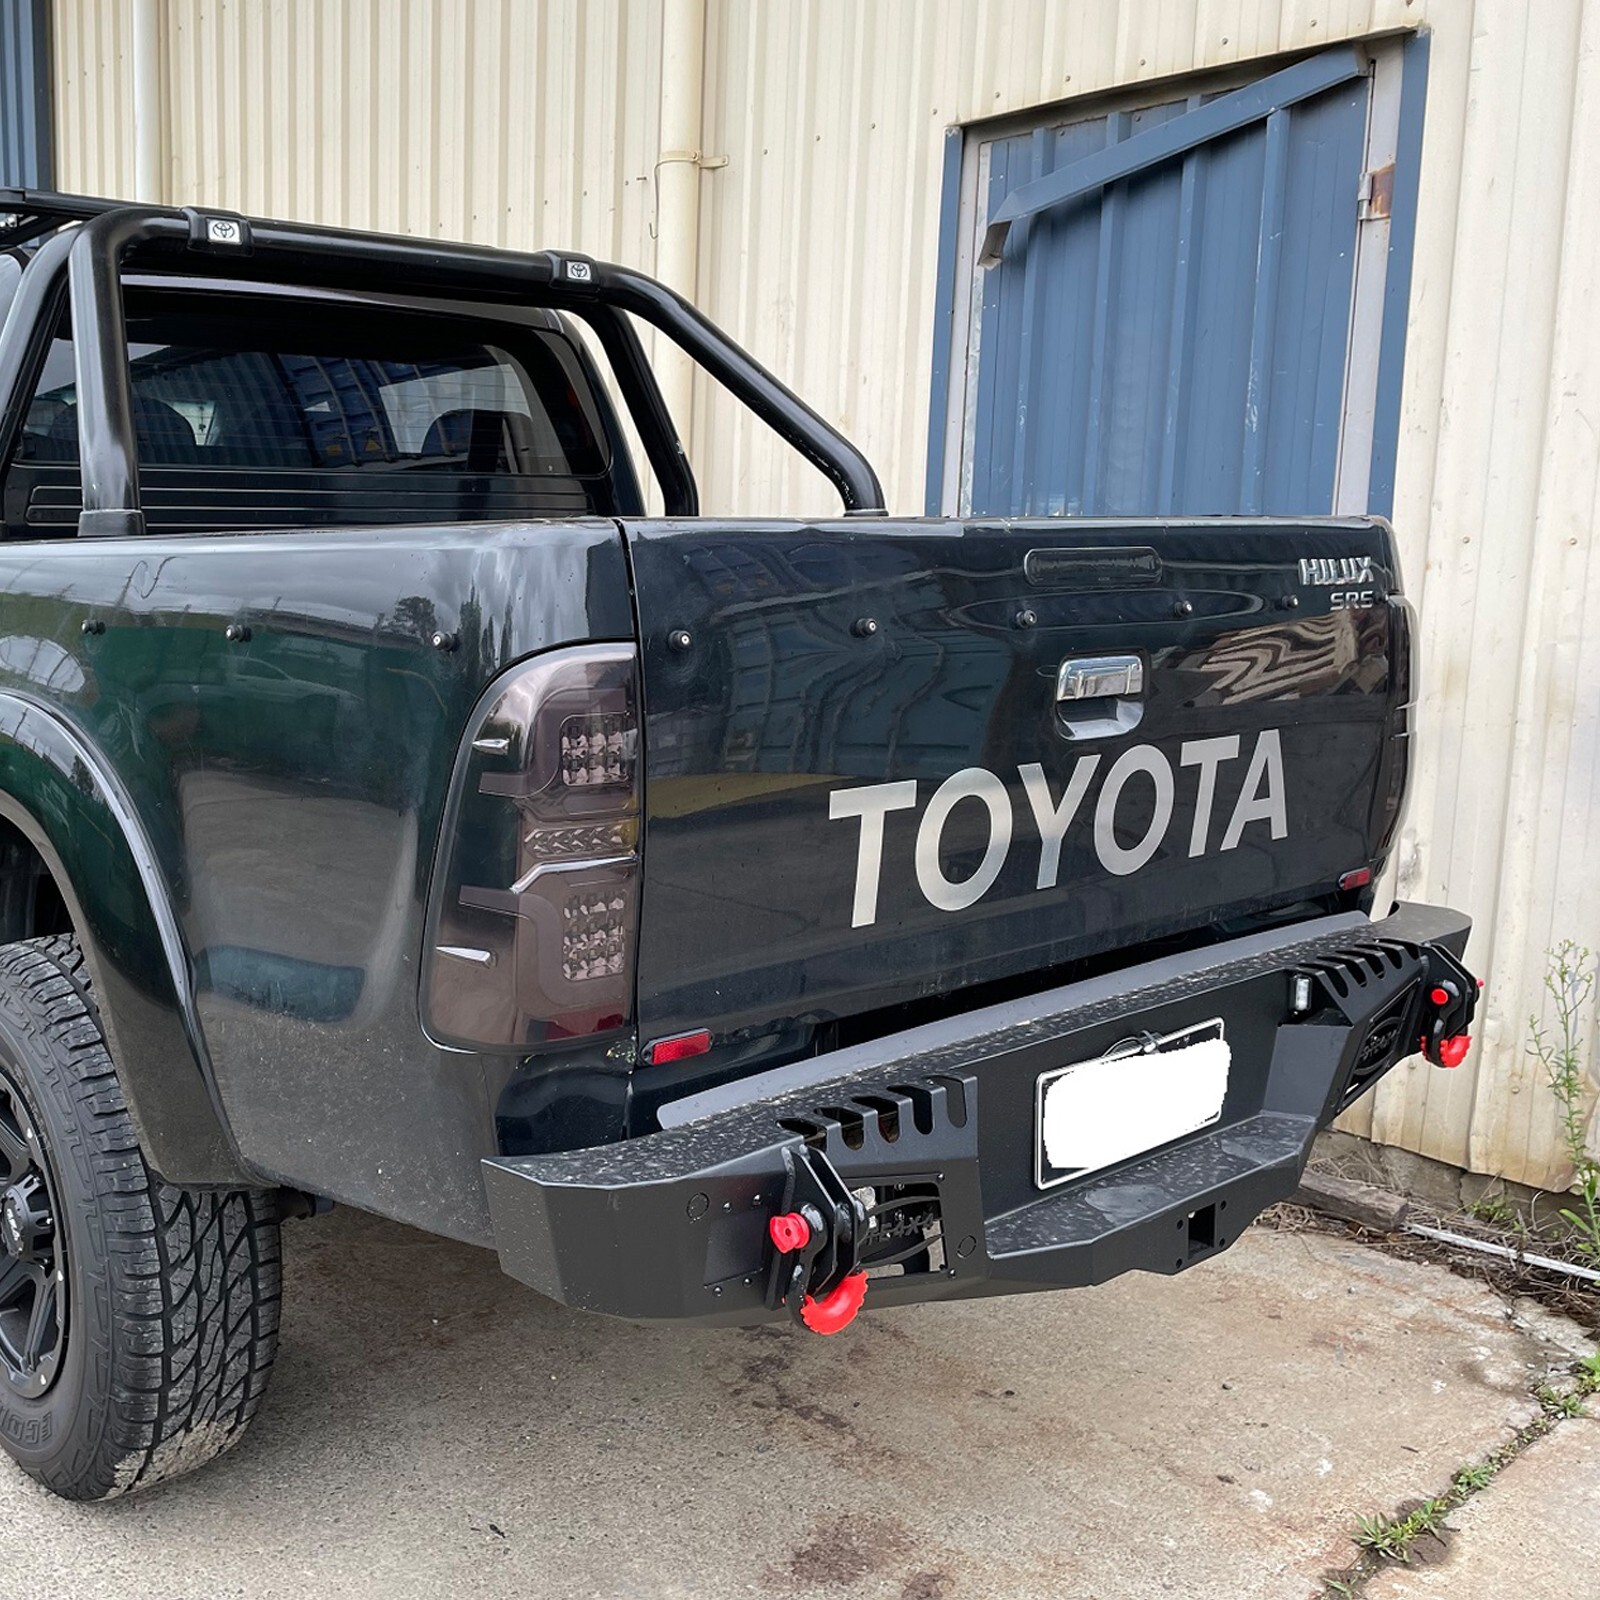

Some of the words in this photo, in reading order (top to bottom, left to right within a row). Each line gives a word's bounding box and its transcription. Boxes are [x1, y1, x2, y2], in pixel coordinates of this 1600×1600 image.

[1299, 557, 1374, 585] HILUX
[1330, 591, 1374, 611] SR5
[829, 729, 1288, 928] TOYOTA
